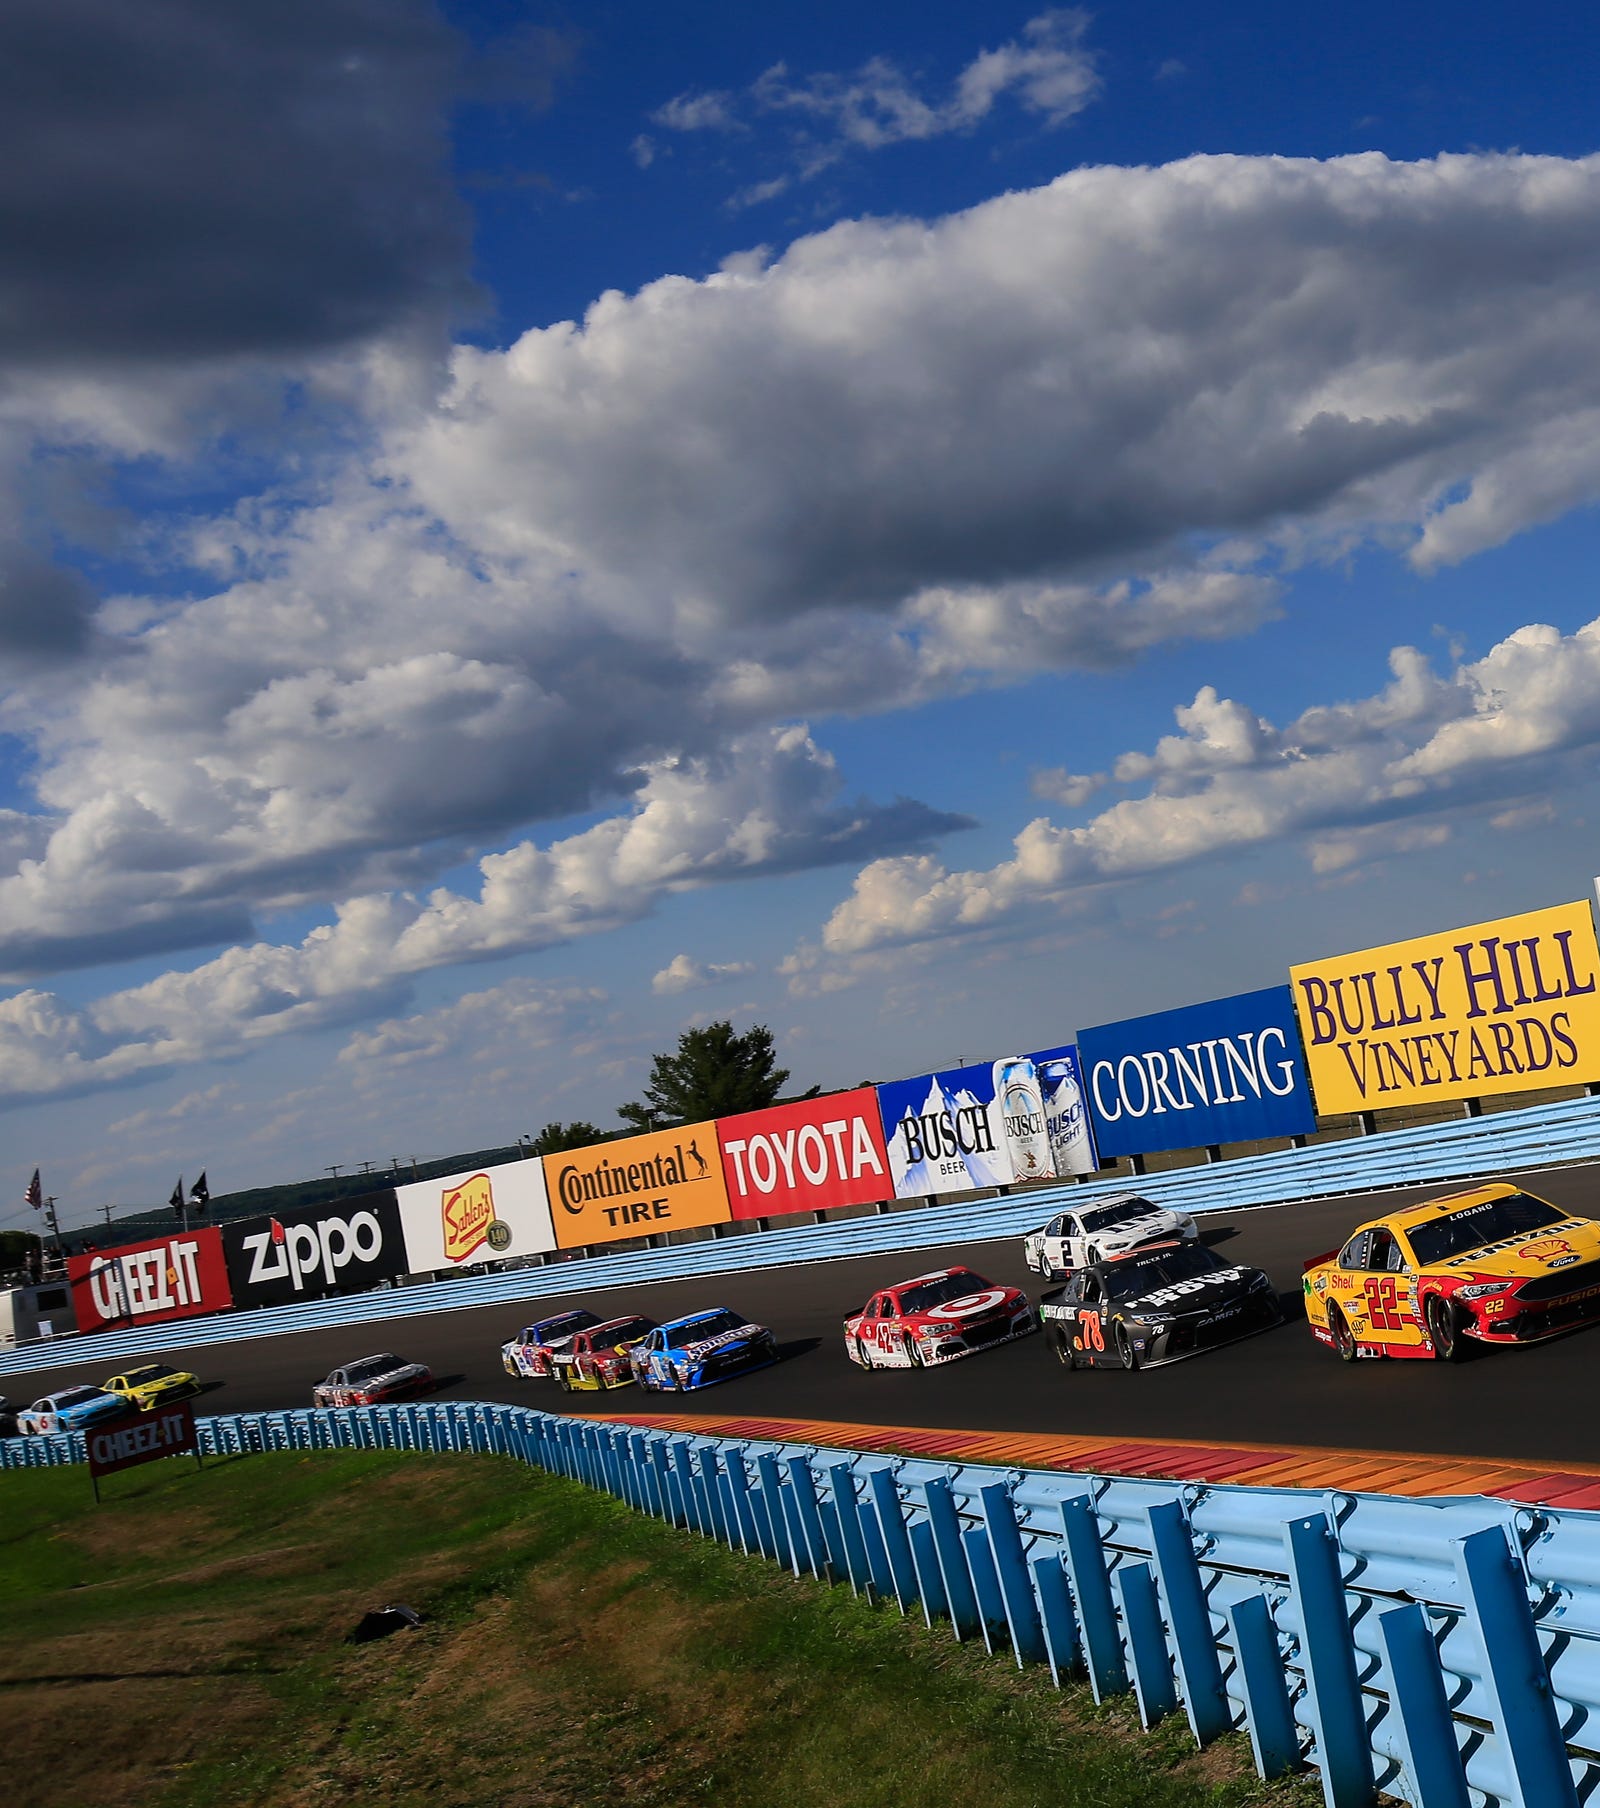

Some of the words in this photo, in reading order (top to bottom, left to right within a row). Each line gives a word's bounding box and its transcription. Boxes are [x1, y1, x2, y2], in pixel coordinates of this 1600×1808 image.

[1299, 957, 1446, 1046] BULLY
[1454, 930, 1596, 1019] HILL
[1337, 1011, 1578, 1099] VINEYARDS
[1092, 1027, 1295, 1121] CORNING
[899, 1103, 996, 1165] BUSCH
[1004, 1111, 1045, 1138] BUSCH
[724, 1116, 884, 1197] TOYOTA
[939, 1160, 967, 1176] BEER
[558, 1144, 689, 1215] Continental
[602, 1198, 672, 1226] TIRE
[1450, 1203, 1493, 1221] LOGANO
[1060, 1239, 1075, 1268] 2
[1445, 1219, 1591, 1268] PENNZOIL
[1552, 1255, 1576, 1267] Ford
[1331, 1274, 1355, 1289] Shell
[1363, 1276, 1404, 1331] 22
[1484, 1298, 1504, 1315] 22
[1078, 1308, 1105, 1352] 78
[1151, 1323, 1165, 1336] 78
